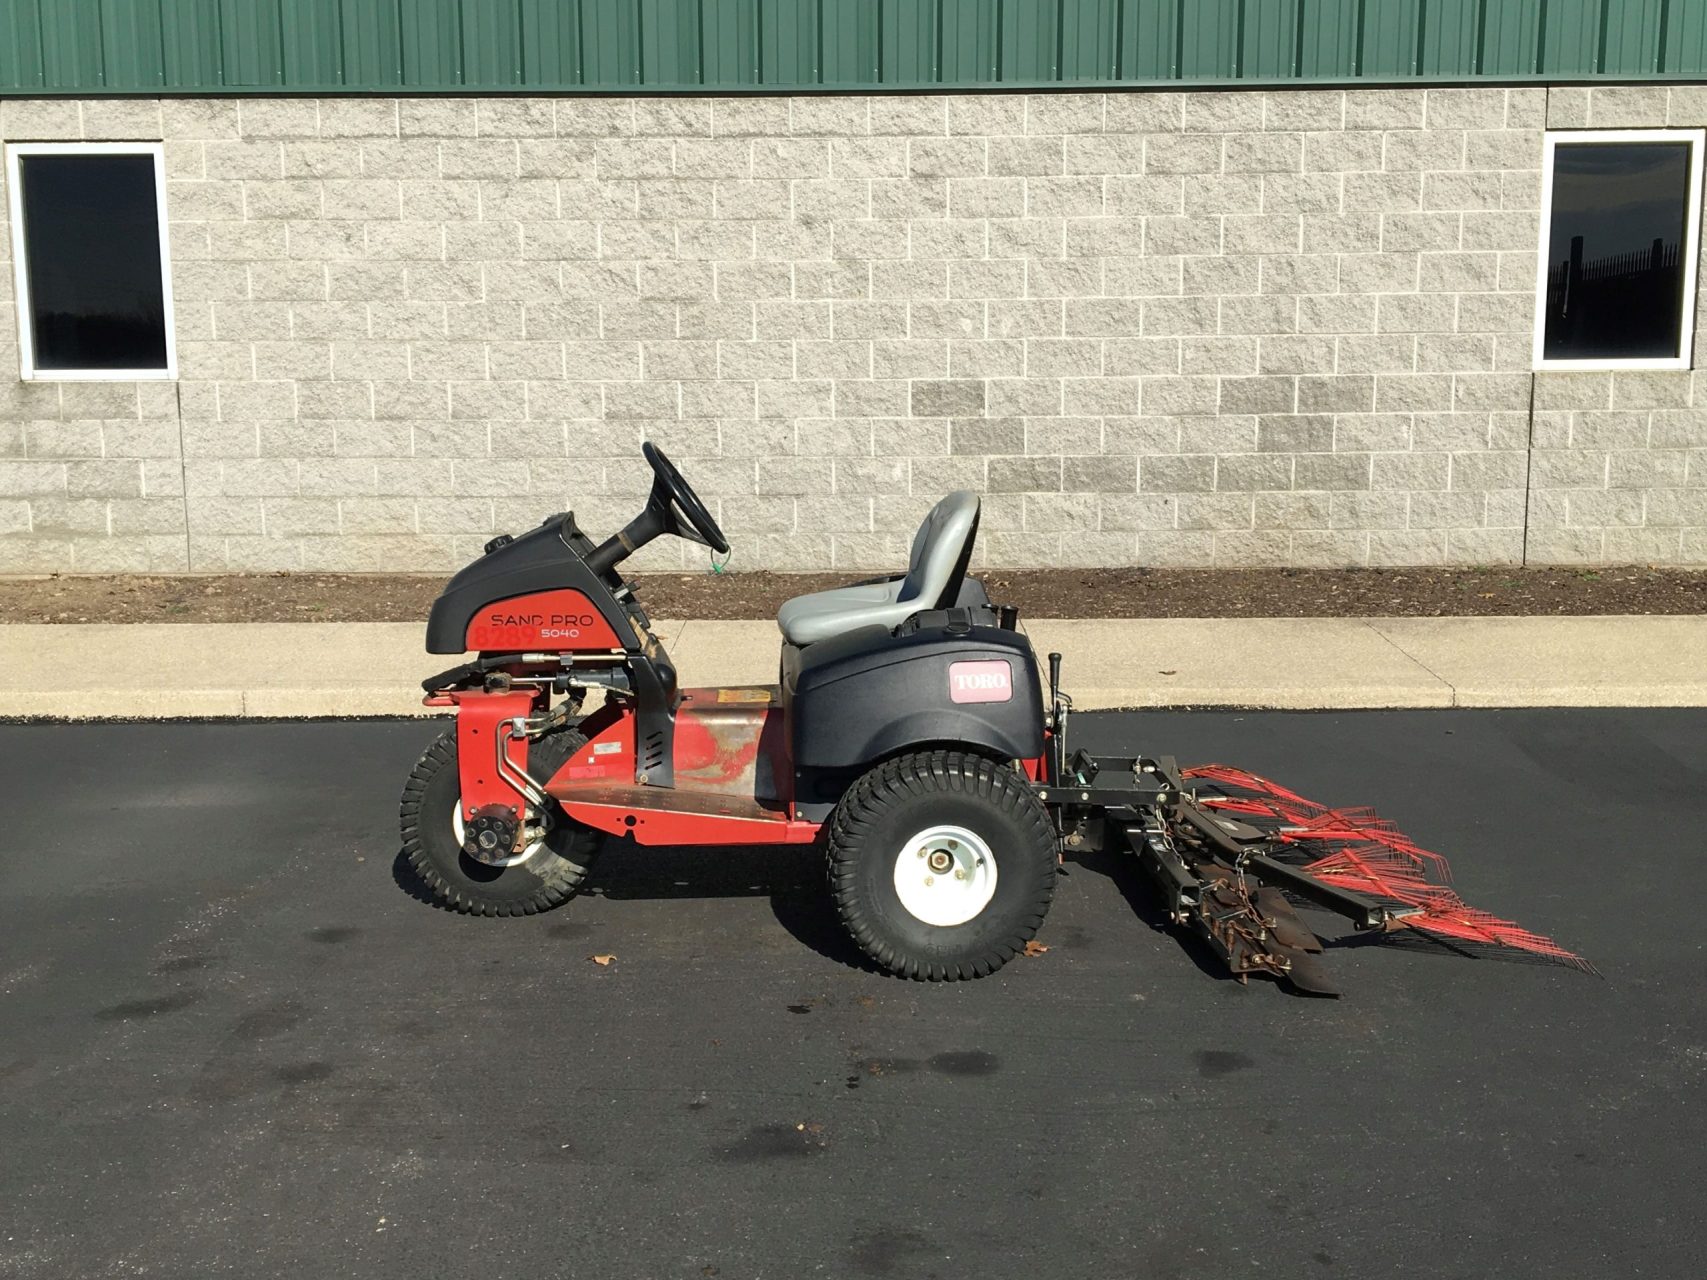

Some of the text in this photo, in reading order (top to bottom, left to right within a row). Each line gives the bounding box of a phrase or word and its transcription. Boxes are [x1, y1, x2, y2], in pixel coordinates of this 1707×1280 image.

[492, 614, 594, 627] SAND PRO
[541, 629, 579, 638] 5040
[954, 672, 1006, 690] TORO
